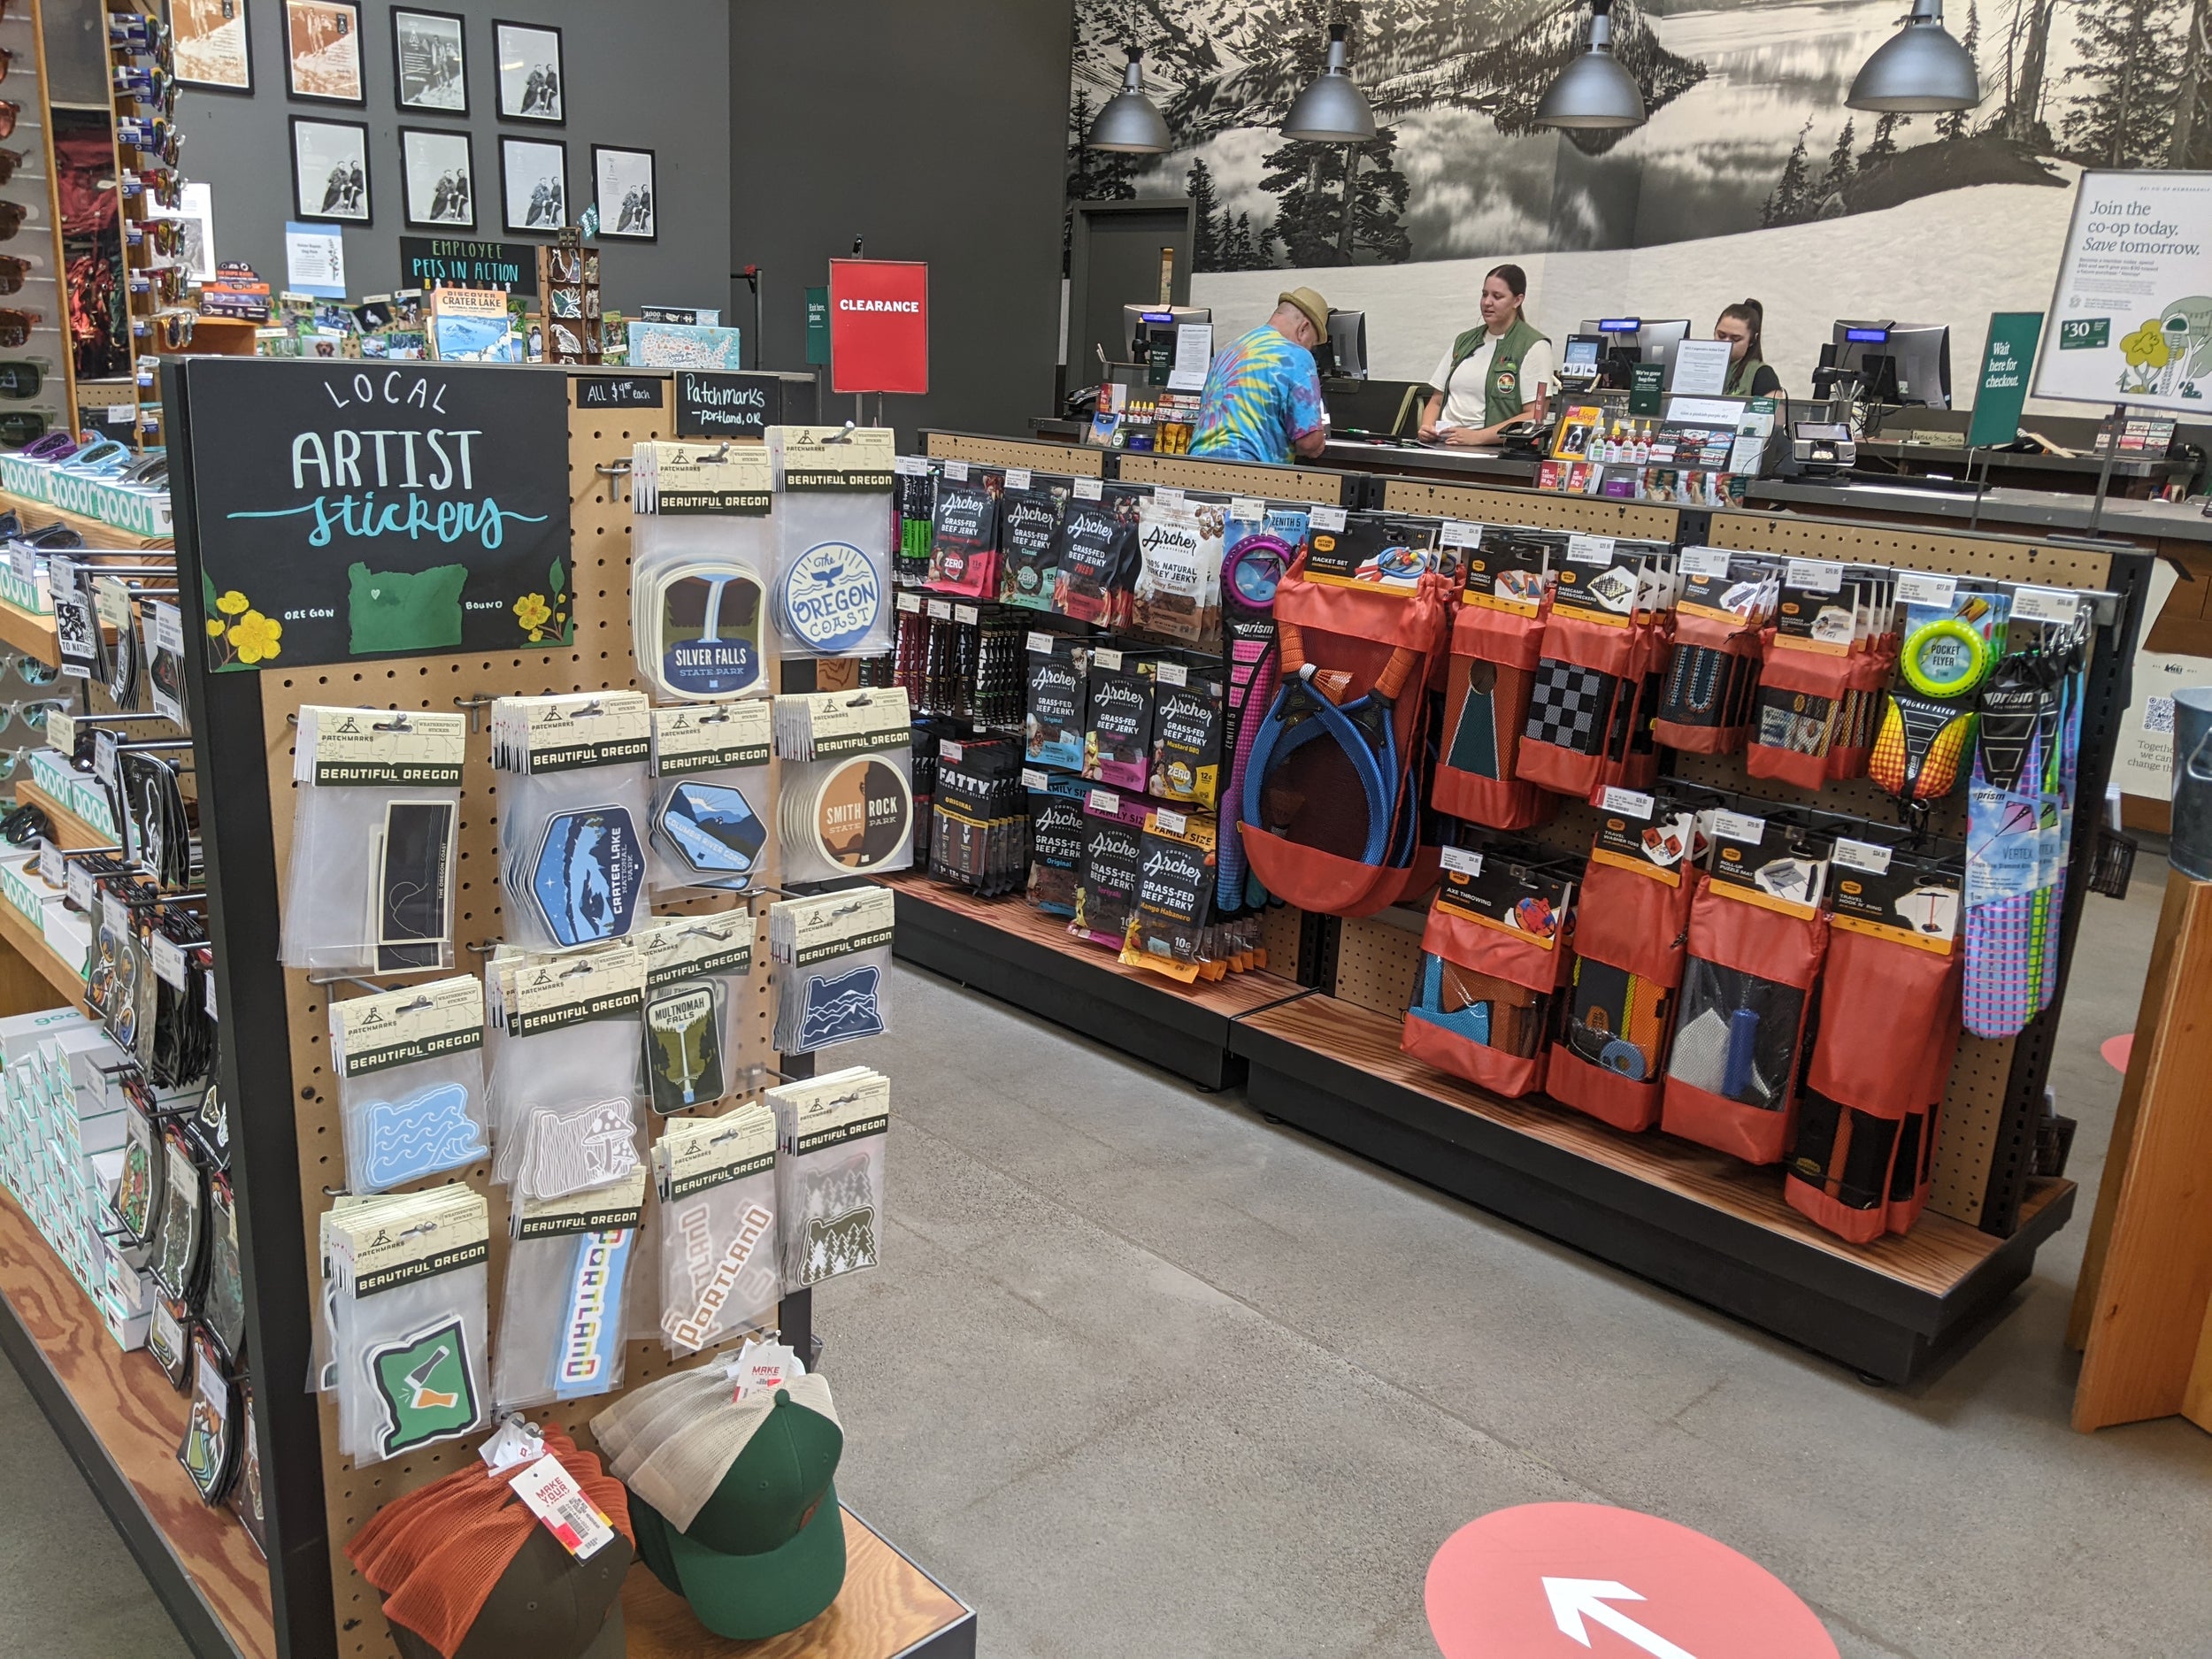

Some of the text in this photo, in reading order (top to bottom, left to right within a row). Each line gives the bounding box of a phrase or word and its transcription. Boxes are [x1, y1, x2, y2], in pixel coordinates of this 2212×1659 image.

[2090, 201, 2150, 215] Join the
[2088, 221, 2178, 236] co-op today.
[433, 241, 503, 258] EMPLOYEE
[2083, 238, 2200, 255] Save tomorrow.
[413, 258, 518, 282] PETS IN ACTION
[442, 296, 501, 307] CRATER LAKE
[840, 299, 919, 312] CLEARANCE
[2063, 322, 2089, 337] $30
[1993, 342, 2010, 355] Wait
[1989, 357, 2017, 372] here for
[1985, 374, 2019, 388] checkout.
[326, 371, 447, 414] LOCAL
[588, 386, 650, 403] ALL each
[685, 373, 765, 408] Patchmarks
[292, 429, 482, 489] ARTIST
[787, 474, 892, 485] BEAUTIFUL OREGON
[97, 486, 151, 531] goodr
[662, 496, 769, 508] BEAUTIFUL OREGON
[940, 493, 984, 517] Archer
[227, 492, 548, 549] stickers
[945, 517, 977, 527] GRASS-FED
[1008, 503, 1054, 530] Archer
[1272, 518, 1294, 527] ZENITH
[956, 526, 979, 536] JERKY
[1014, 529, 1048, 541] GRASS-FED
[1067, 513, 1113, 544] Archer
[1012, 536, 1051, 549] BEEF JERKY
[1142, 526, 1196, 556] Archer
[1072, 544, 1105, 558] GRASS-FED
[814, 553, 835, 568] The
[944, 558, 964, 570] ZERO
[1069, 551, 1107, 568] BEEF JERKY
[1162, 562, 1197, 575] NATURAL
[1171, 572, 1197, 584] JERKY
[1167, 582, 1187, 592] Smoke
[284, 600, 503, 619] OREGON BOUND
[792, 583, 876, 625] OREGON
[810, 608, 870, 637] COAST
[1240, 621, 1274, 635] prism
[62, 641, 70, 650] TO
[1932, 645, 1960, 656] POCKET
[676, 648, 747, 666] SILVER FALLS
[977, 638, 987, 689] FATTY
[1932, 656, 1955, 667] FLYER
[680, 668, 712, 677] STATE
[1032, 667, 1076, 692] Archer
[1038, 697, 1072, 708] GRASS-FED
[1094, 682, 1144, 710] Archer
[1051, 706, 1075, 716] JERKY
[1160, 695, 1212, 727] Archer
[1901, 698, 1931, 711] POCKET
[814, 712, 849, 721] PATCHMARKS
[1100, 713, 1136, 726] GRASS-FED
[531, 721, 574, 730] PATCHMARKS
[661, 728, 702, 737] PATCHMARKS
[1097, 720, 1140, 735] BEEF JERKY
[1167, 722, 1205, 738] GRASS-FED
[817, 732, 910, 752] BEAUTIFUL OREGON
[1164, 729, 1208, 748] BEEF JERKY
[534, 742, 648, 765] BEAUTIFUL OREGON
[1166, 741, 1187, 752] Mustard
[2138, 740, 2174, 753] Togethe
[662, 749, 768, 770] BEAUTIFUL OREGON
[2127, 758, 2173, 773] change th
[2155, 753, 2172, 764] can
[320, 768, 458, 780] BEAUTIFUL OREGON
[1168, 765, 1190, 780] ZERO
[33, 759, 72, 804] goodr
[940, 766, 990, 795] FATTY
[945, 796, 972, 811] ORIGINAL
[1976, 791, 2005, 801] prism
[826, 796, 898, 826] SMITH ROCK
[829, 816, 896, 834] STATE PARK
[1035, 807, 1083, 833] Arche
[665, 816, 702, 844] COLUMBIA
[1035, 833, 1081, 850] GRASS-FE
[1190, 833, 1213, 846] SIZE
[1035, 843, 1081, 858] BEEF JERK
[2003, 845, 2032, 860] VERTEX
[1047, 857, 1071, 868] Original
[1143, 850, 1202, 886] Archer
[1090, 871, 1106, 883] BEEF
[613, 858, 622, 914] CRATER
[1143, 880, 1194, 902] GRASS-FED
[1141, 889, 1194, 911] BEEF JERKY
[1447, 887, 1492, 906] AXE THROWING
[1160, 908, 1191, 922] Habanero
[799, 931, 892, 963] BEAUTIFUL OREGON
[649, 950, 749, 985] EAUTIFUL OREGON
[655, 997, 704, 1021] MULTNOMAH
[524, 1006, 589, 1029] BEAUTIFUL
[666, 1011, 695, 1025] FALLS
[350, 1031, 480, 1070] BEAUTIFUL OREGON
[799, 1129, 847, 1149] BEAUTIFUL
[675, 1170, 730, 1194] BEAUTIFUL
[359, 1263, 430, 1290] BEAUTIFUL
[673, 1208, 771, 1347] PORTLAND
[752, 1366, 780, 1375] MAKE
[535, 1477, 563, 1500] MAKE
[541, 1485, 568, 1503] YOUR
